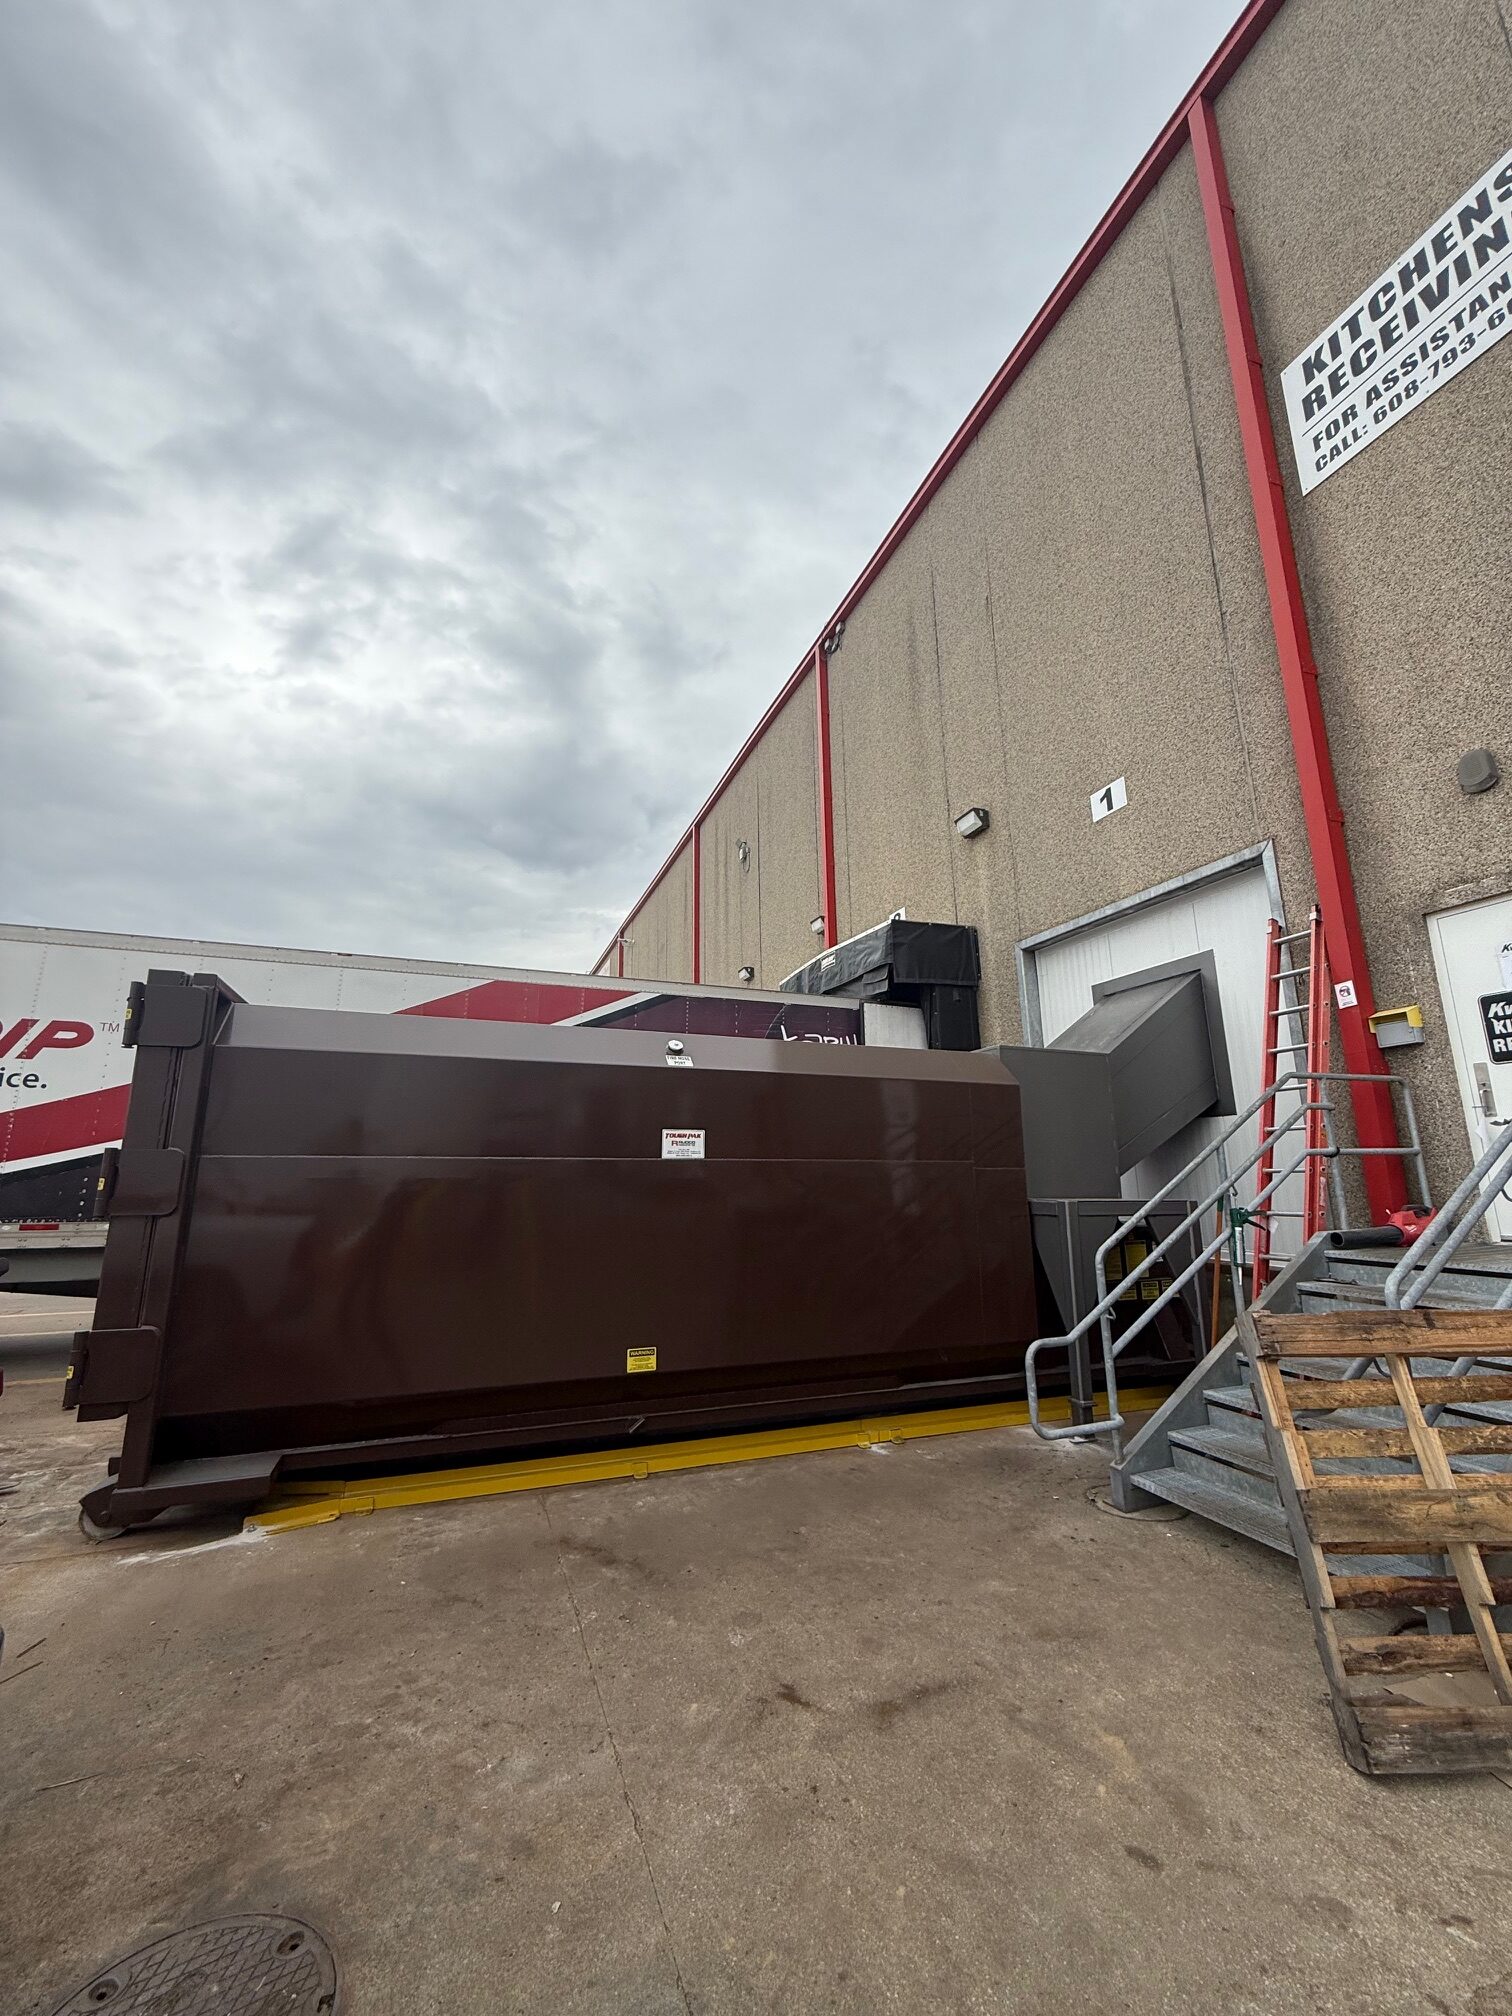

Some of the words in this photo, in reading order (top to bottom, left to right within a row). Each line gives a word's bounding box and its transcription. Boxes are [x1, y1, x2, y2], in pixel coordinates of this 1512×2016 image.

[1301, 162, 1512, 387] KITCHENS
[1301, 211, 1512, 423] RECEIVIN
[1312, 405, 1361, 453] FOR
[1314, 423, 1369, 474] CALL:
[1100, 786, 1114, 812] 1
[0, 1018, 95, 1060] IP
